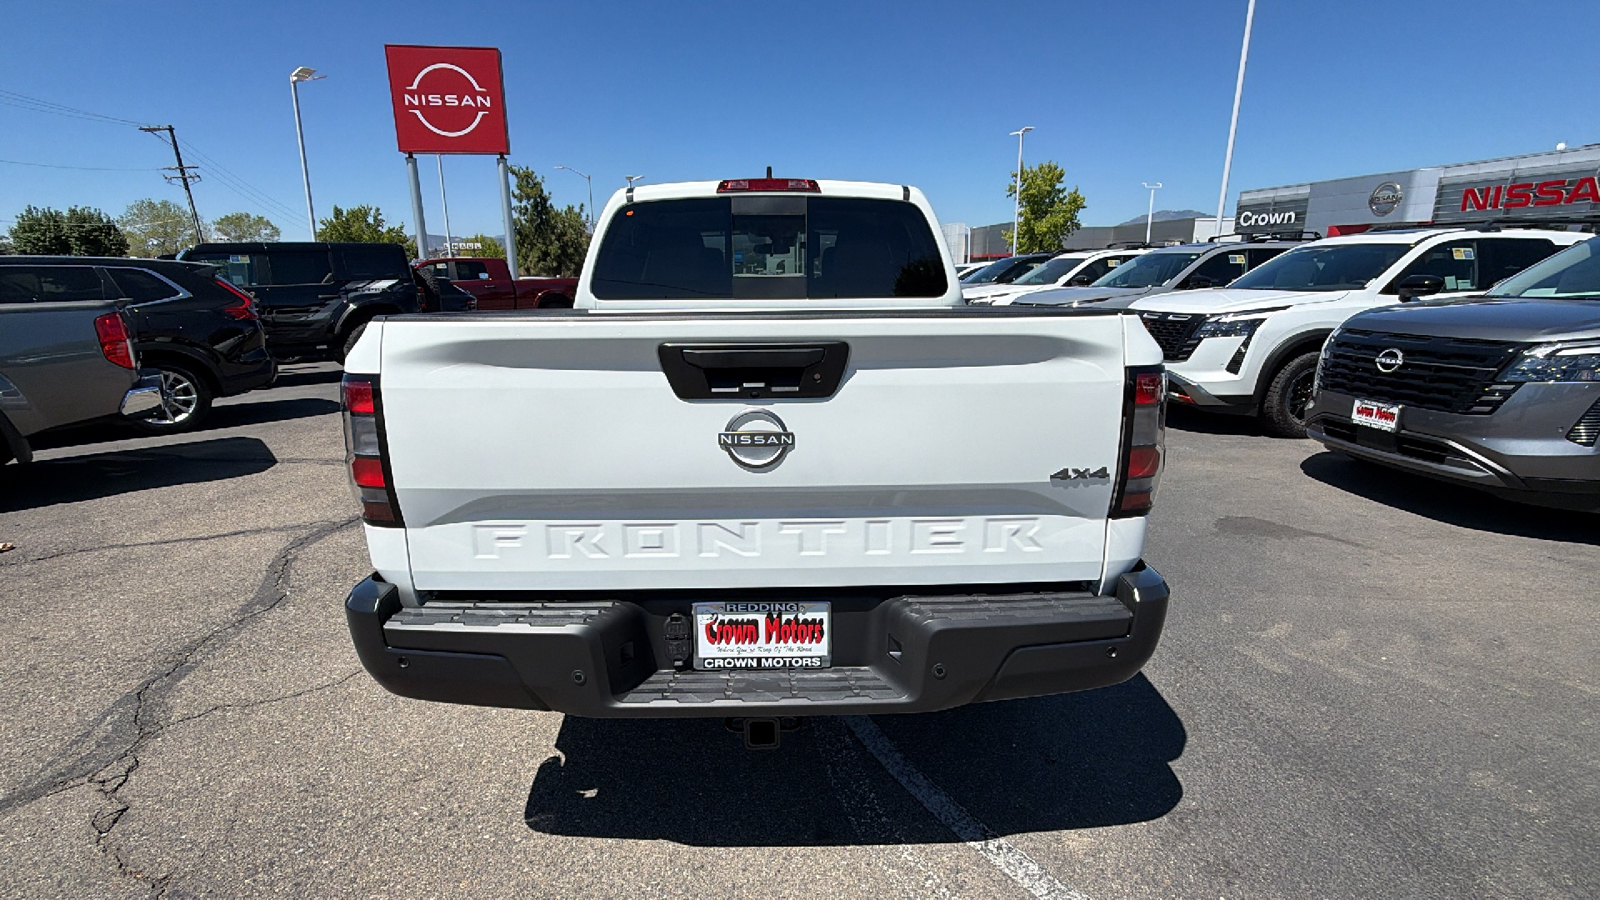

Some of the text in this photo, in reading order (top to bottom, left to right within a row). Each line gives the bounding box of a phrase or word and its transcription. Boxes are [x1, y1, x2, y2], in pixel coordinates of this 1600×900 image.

[403, 93, 491, 108] NISSAN
[1240, 211, 1296, 227] Crown
[720, 434, 793, 444] NISSAN
[472, 517, 1044, 560] FRONTIER
[726, 603, 798, 612] REDDING
[704, 611, 825, 645] Crown Motors
[704, 657, 821, 669] CROWN MOTORS
